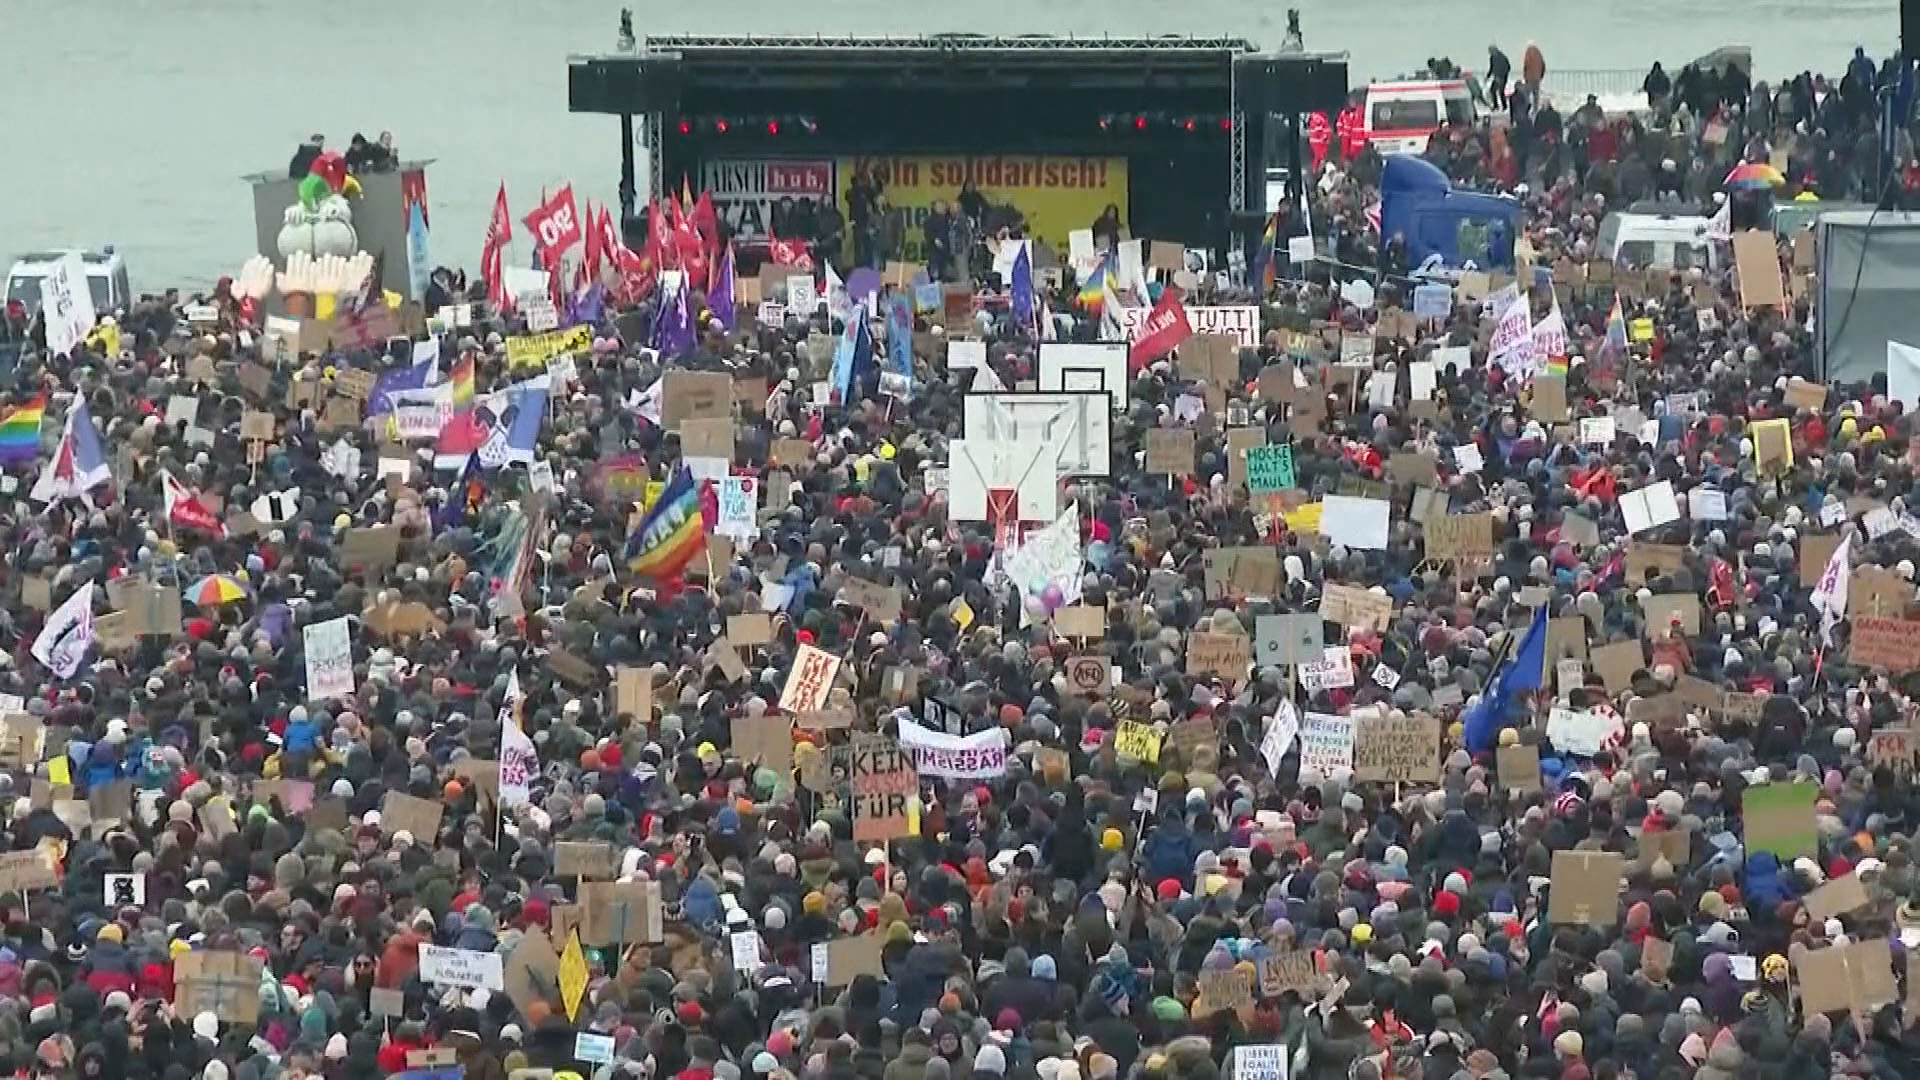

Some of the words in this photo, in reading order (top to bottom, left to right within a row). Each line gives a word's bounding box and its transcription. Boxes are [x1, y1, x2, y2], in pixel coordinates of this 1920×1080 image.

[931, 157, 1107, 188] solidarisch!
[1196, 309, 1254, 328] TUTTI
[853, 751, 915, 776] KEIN
[854, 793, 905, 818] FÜR
